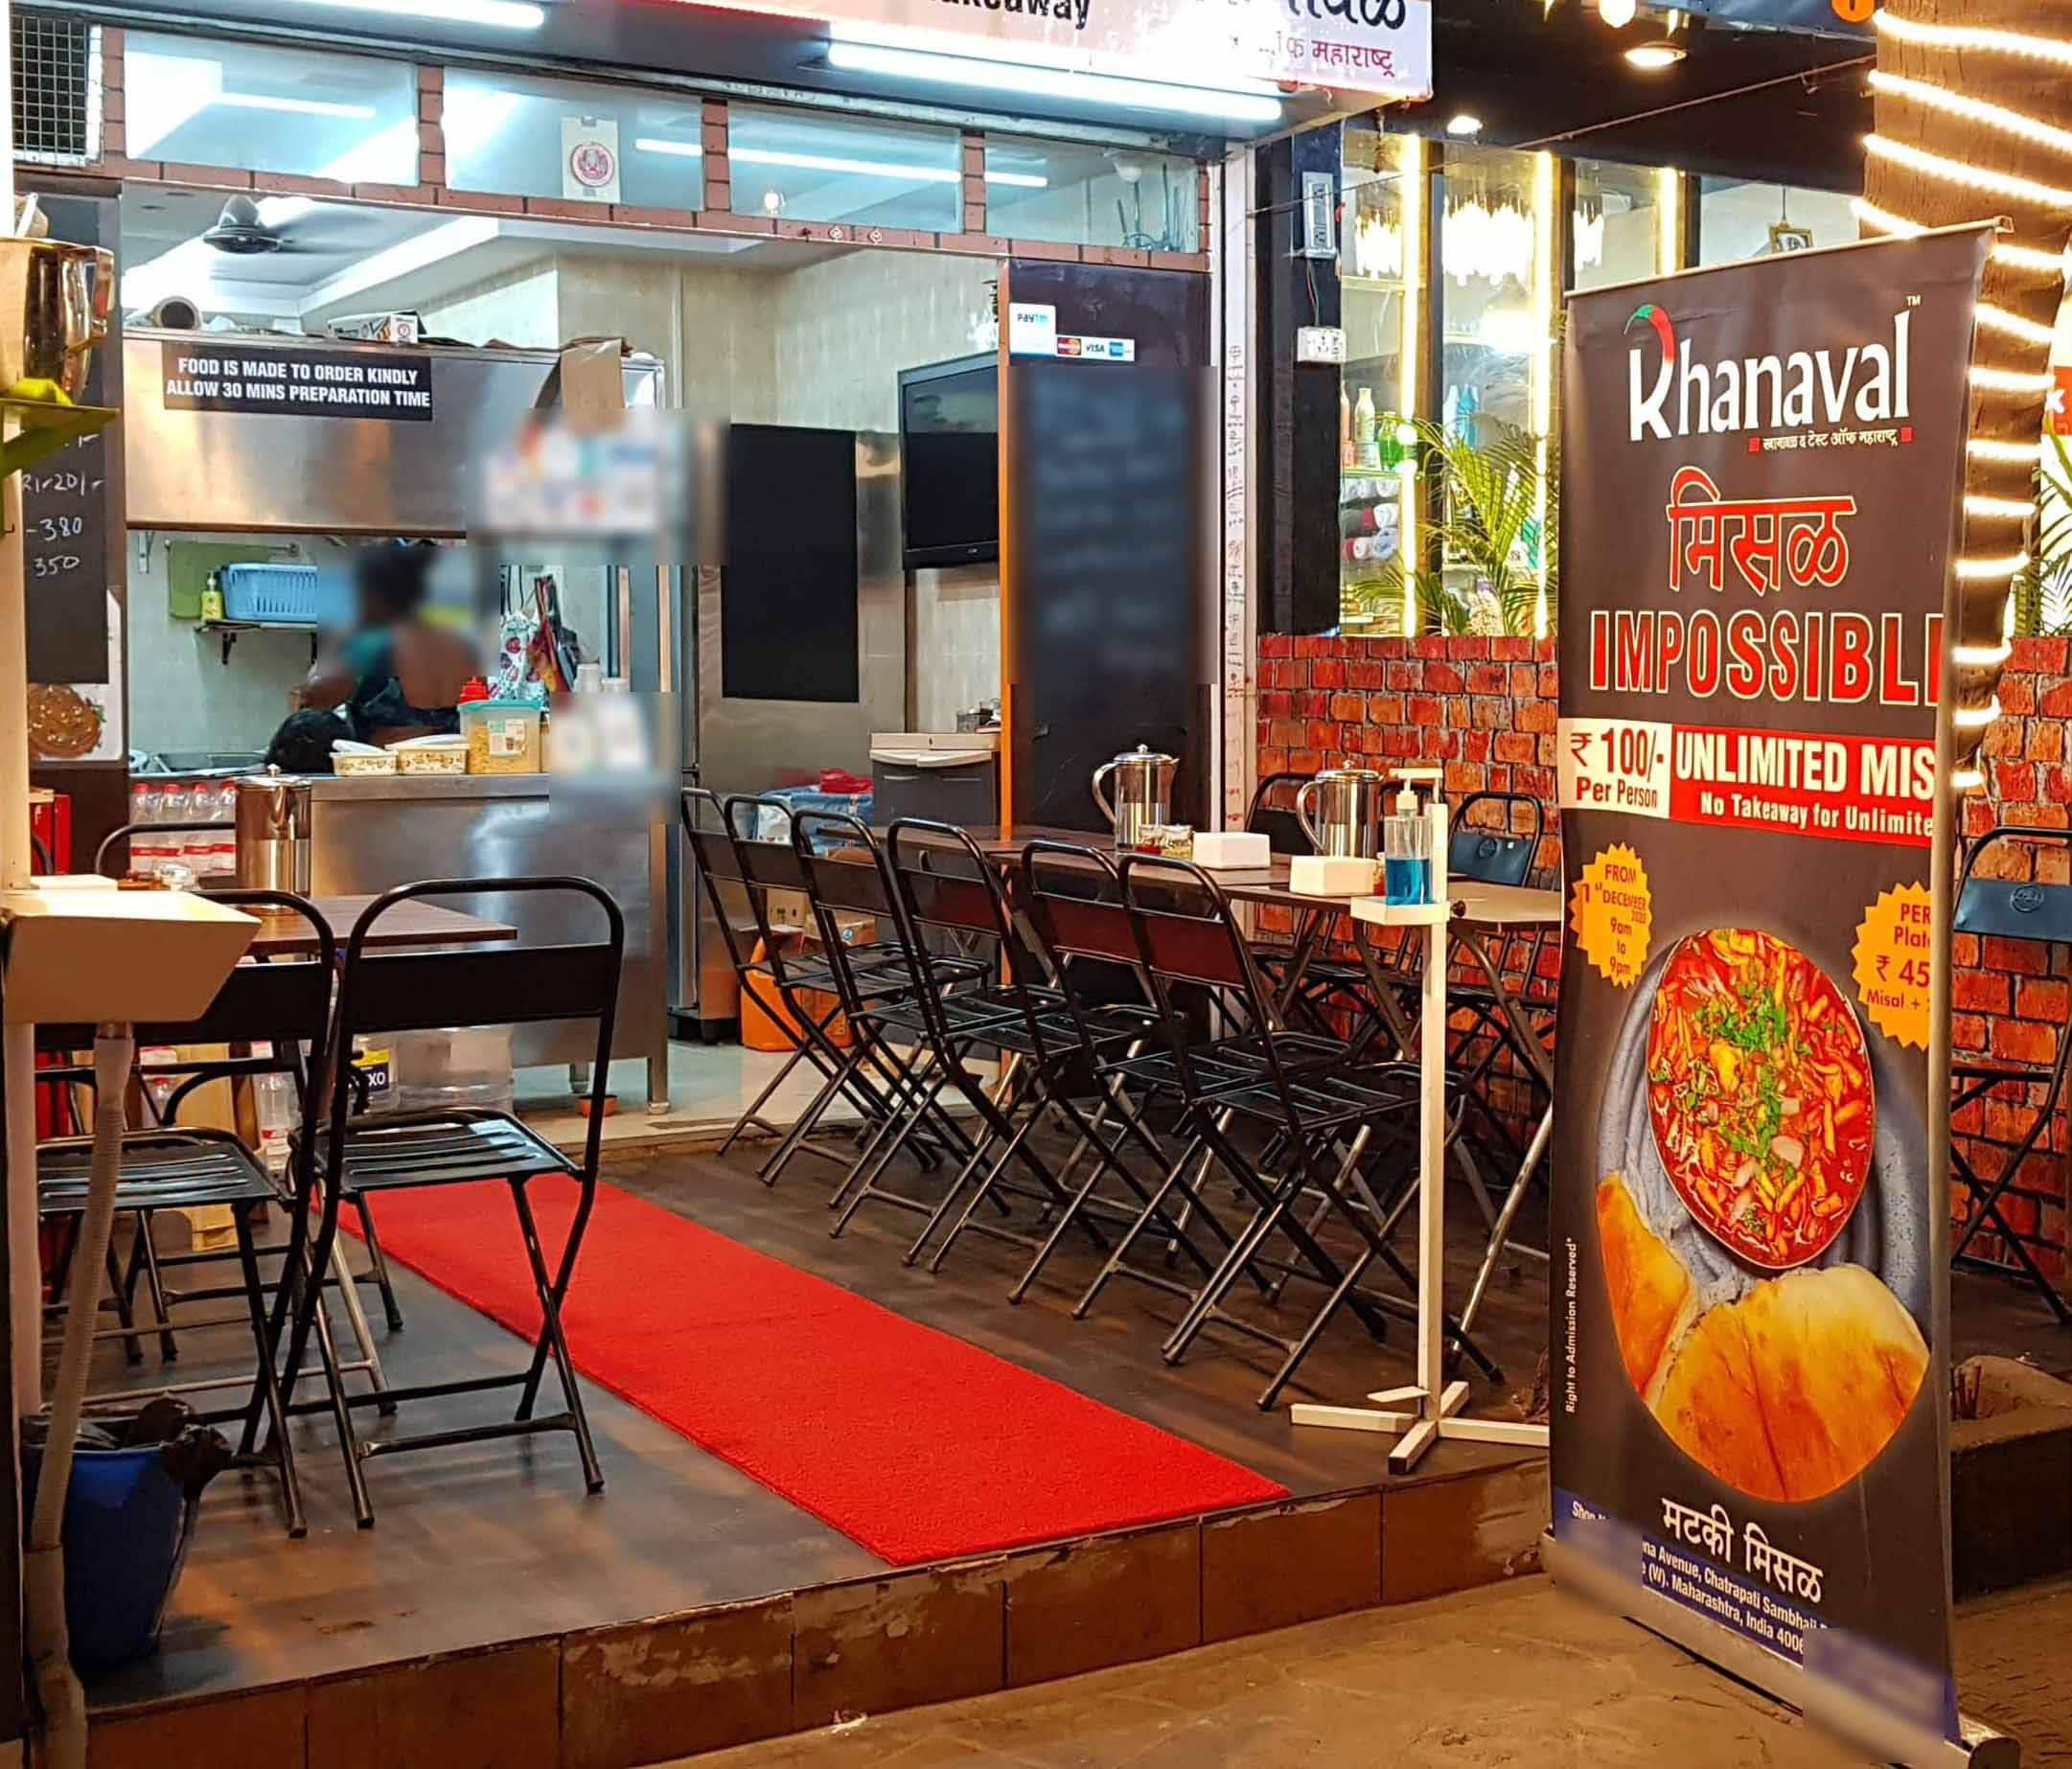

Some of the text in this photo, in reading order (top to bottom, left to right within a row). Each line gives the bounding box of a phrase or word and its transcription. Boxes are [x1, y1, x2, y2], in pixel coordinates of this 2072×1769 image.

[1311, 39, 1395, 77] महाराष्ट्र
[1086, 343, 1105, 353] VISA
[178, 358, 418, 384] FOOD IS MADE TO ORDER KINDLY
[1624, 295, 1921, 442] Khanaval TM
[166, 379, 430, 407] ALLOW 30 MINS PREPARATION TIME
[1666, 466, 1857, 596] मिसळ
[34, 555, 81, 577] 350
[1571, 732, 1593, 768] ₹
[1676, 731, 1848, 793] UNLIMITED
[1576, 776, 1658, 809] Per Person
[1701, 792, 1724, 816] No
[1731, 793, 1808, 829] Takeaway
[1813, 803, 1839, 828] for
[1604, 863, 1637, 884] FROM
[1602, 889, 1646, 910] DECEMBER
[1900, 903, 1930, 925] PER
[1610, 916, 1633, 936] 9am
[1617, 940, 1626, 955] to
[1609, 956, 1631, 978] 9pm
[1876, 954, 1930, 989] ₹ 45
[1866, 988, 1905, 1009] Misal
[1565, 1300, 1577, 1365] Admission
[1566, 1367, 1577, 1379] to
[1565, 1382, 1578, 1413] Right
[1661, 1497, 1824, 1603] मटकी मिसळ
[1659, 1546, 1702, 1582] Avenue,
[1704, 1567, 1761, 1610] Chatrapati
[1671, 1574, 1743, 1627] Maharashtra,
[1746, 1610, 1774, 1639] India
